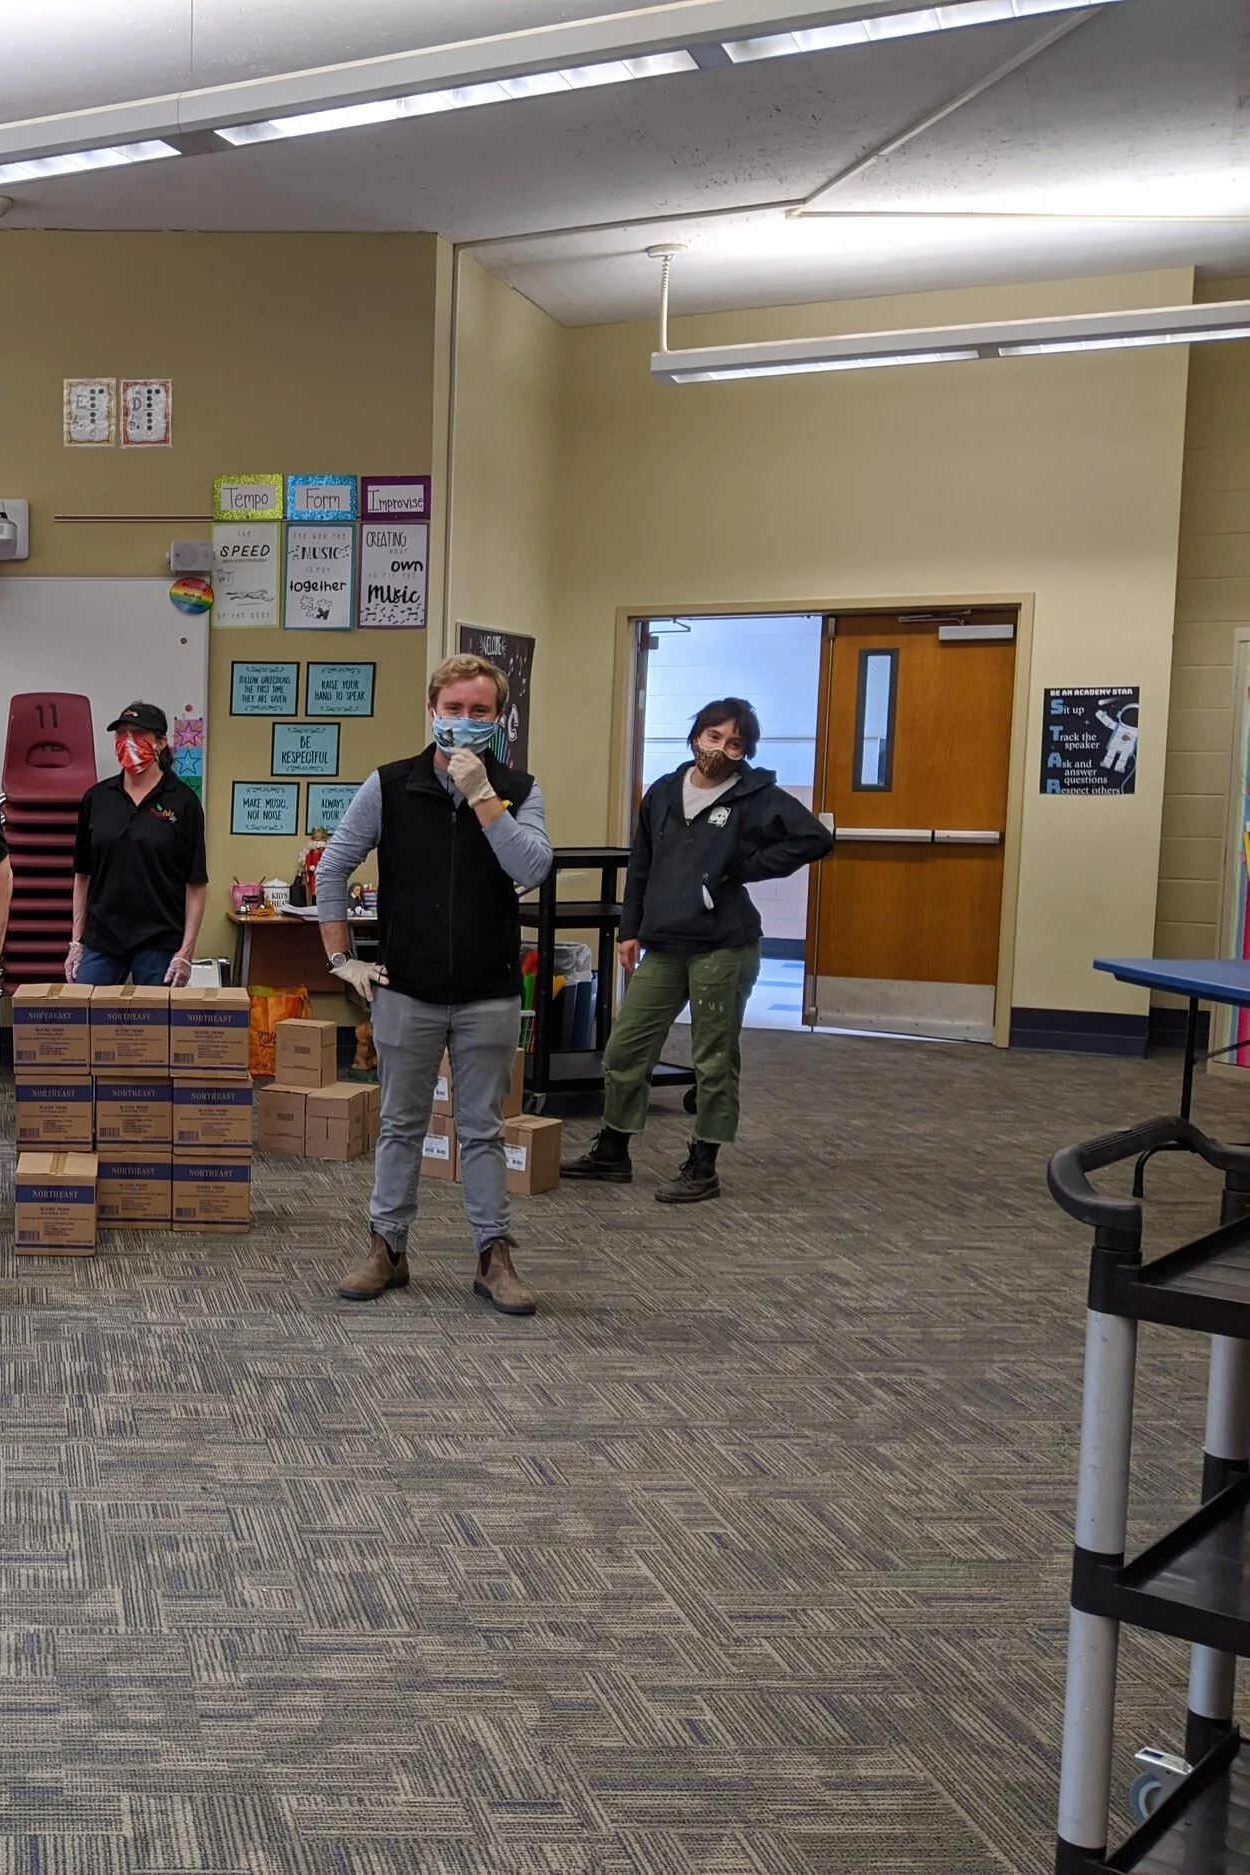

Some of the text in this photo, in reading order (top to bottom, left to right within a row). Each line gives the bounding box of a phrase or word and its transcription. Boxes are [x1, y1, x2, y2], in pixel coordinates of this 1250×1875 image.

[132, 396, 142, 411] D
[224, 488, 268, 510] Tempo
[306, 489, 340, 509] Form
[369, 490, 423, 512] Improvise
[366, 531, 407, 548] CREATING
[220, 544, 271, 558] SPEED
[301, 546, 341, 560] MUSIC
[391, 560, 424, 573] own
[290, 580, 347, 592] together
[368, 584, 421, 604] music
[244, 685, 254, 694] THE
[272, 685, 285, 694] TIME
[321, 679, 360, 690] RAISE YOUR
[314, 691, 366, 701] HAND TO SPEAK
[1050, 688, 1133, 697] BE AN ACADEMY STAR
[258, 694, 268, 703] ARE
[1050, 699, 1085, 716] Sit up
[35, 703, 58, 730] 11
[1049, 725, 1097, 742] Track the
[300, 736, 311, 749] BE
[1064, 741, 1100, 751] speaker
[282, 751, 329, 764] RESPECTFUL
[1047, 752, 1092, 768] Ask and
[1064, 769, 1098, 777] answer
[1064, 776, 1108, 785] questions
[1091, 785, 1121, 795] others
[243, 798, 288, 810] MAKE MUSIC,
[321, 798, 344, 808] ALWAYS
[247, 810, 282, 820] NOT NOISE
[322, 810, 340, 820] YOUR
[271, 892, 288, 900] KID'S
[28, 1012, 72, 1020] NORTHEAST
[107, 1012, 151, 1021] NORTHEAST
[187, 1014, 232, 1023] NORTHEAST
[32, 1089, 76, 1098] NORTHEAST
[112, 1089, 156, 1097] NORTHEAST
[191, 1092, 236, 1101] NORTHEAST
[111, 1167, 156, 1176] NORTHEAST
[189, 1169, 233, 1178] NORTHEAST
[32, 1190, 79, 1199] NORTHEAST
